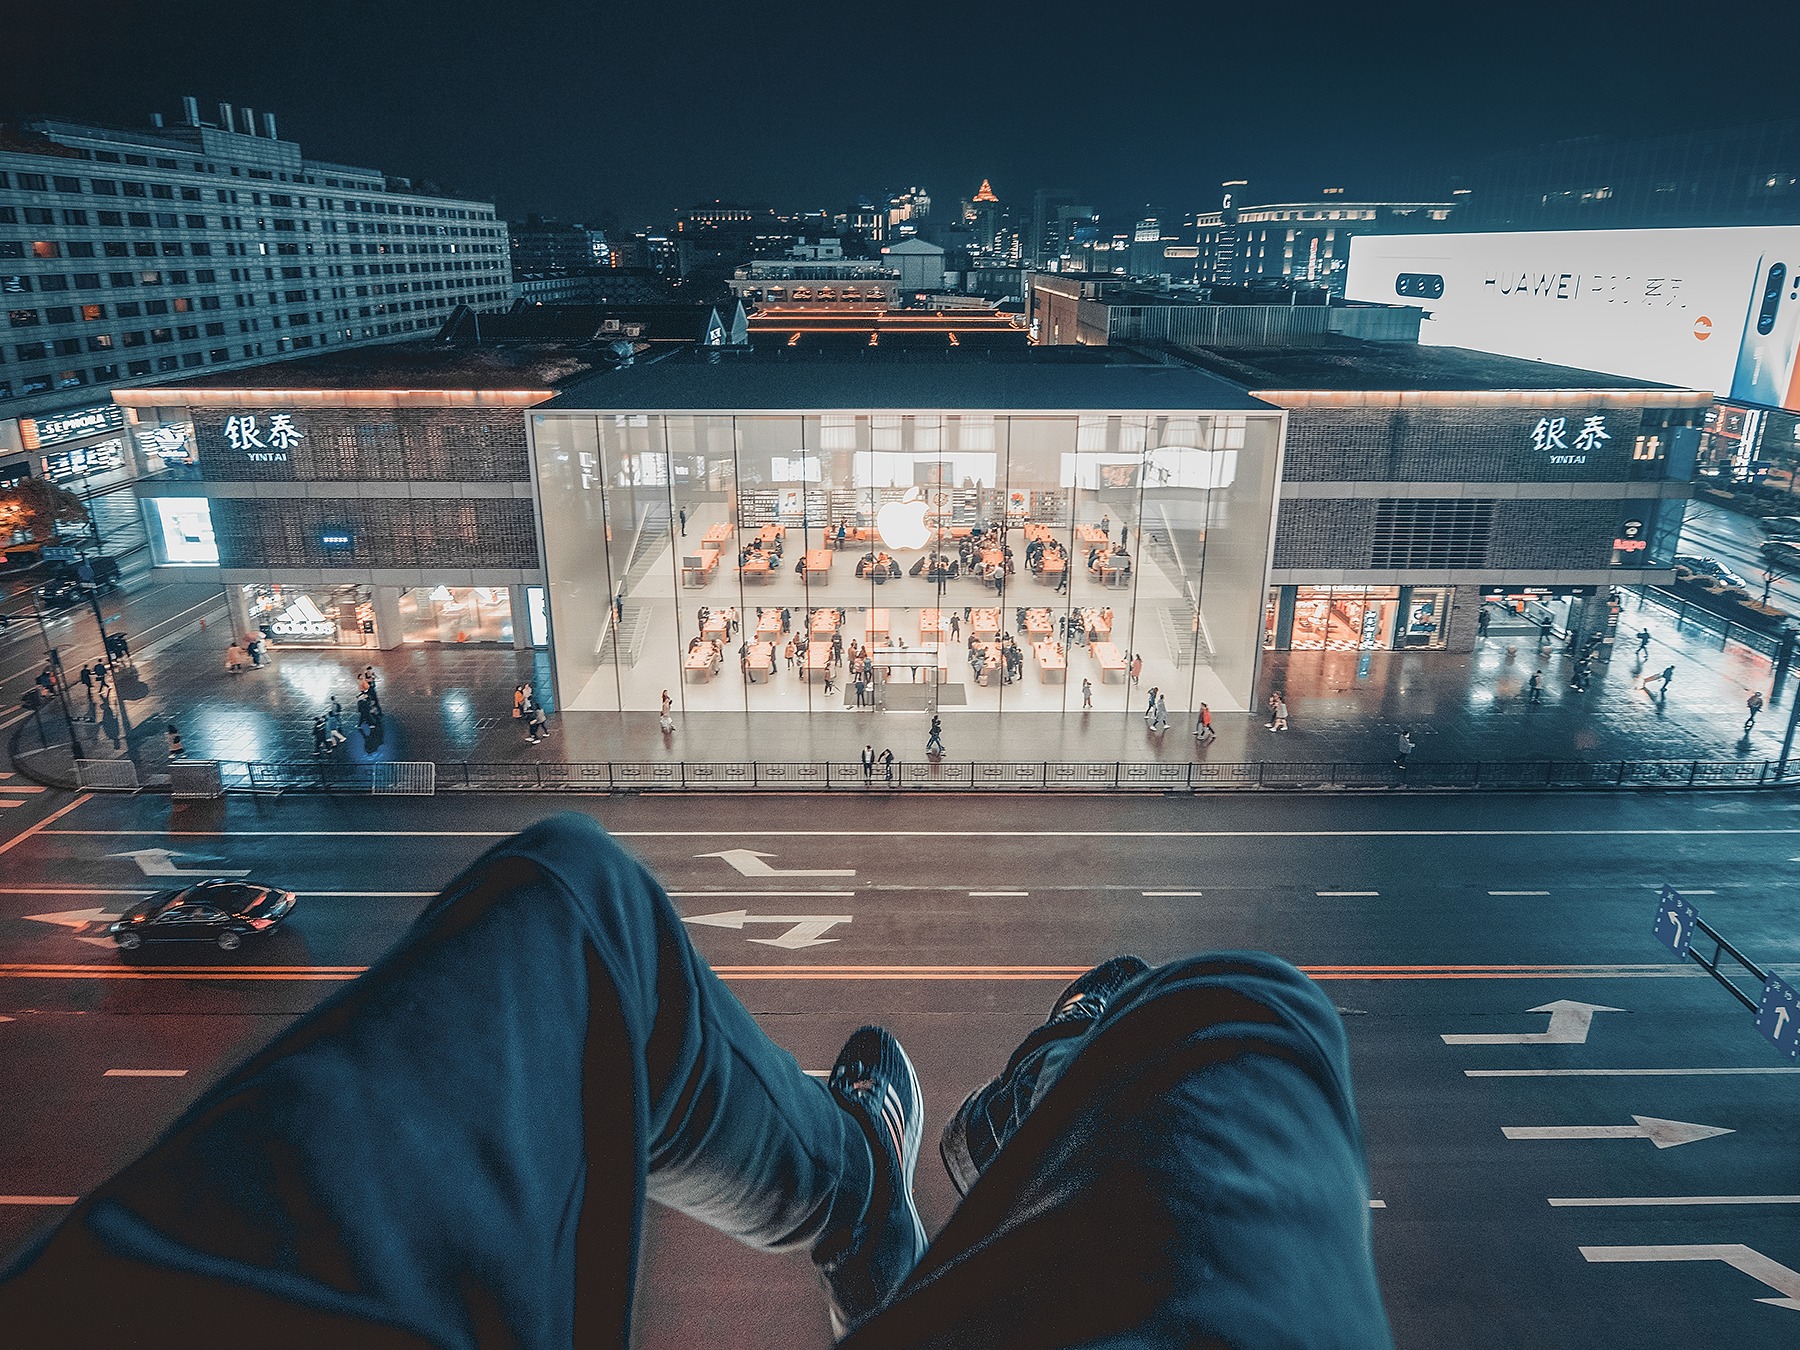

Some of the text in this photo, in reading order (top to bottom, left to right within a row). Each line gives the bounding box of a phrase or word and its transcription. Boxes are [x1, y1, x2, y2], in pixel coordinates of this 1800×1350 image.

[1484, 272, 1580, 299] HUAWEI
[46, 413, 105, 434] SEPHORA
[223, 413, 305, 450] 银泰
[1529, 415, 1612, 451] 银泰
[246, 452, 288, 461] YINTAI
[1549, 455, 1586, 464] YINTAI
[272, 619, 335, 635] adidas
